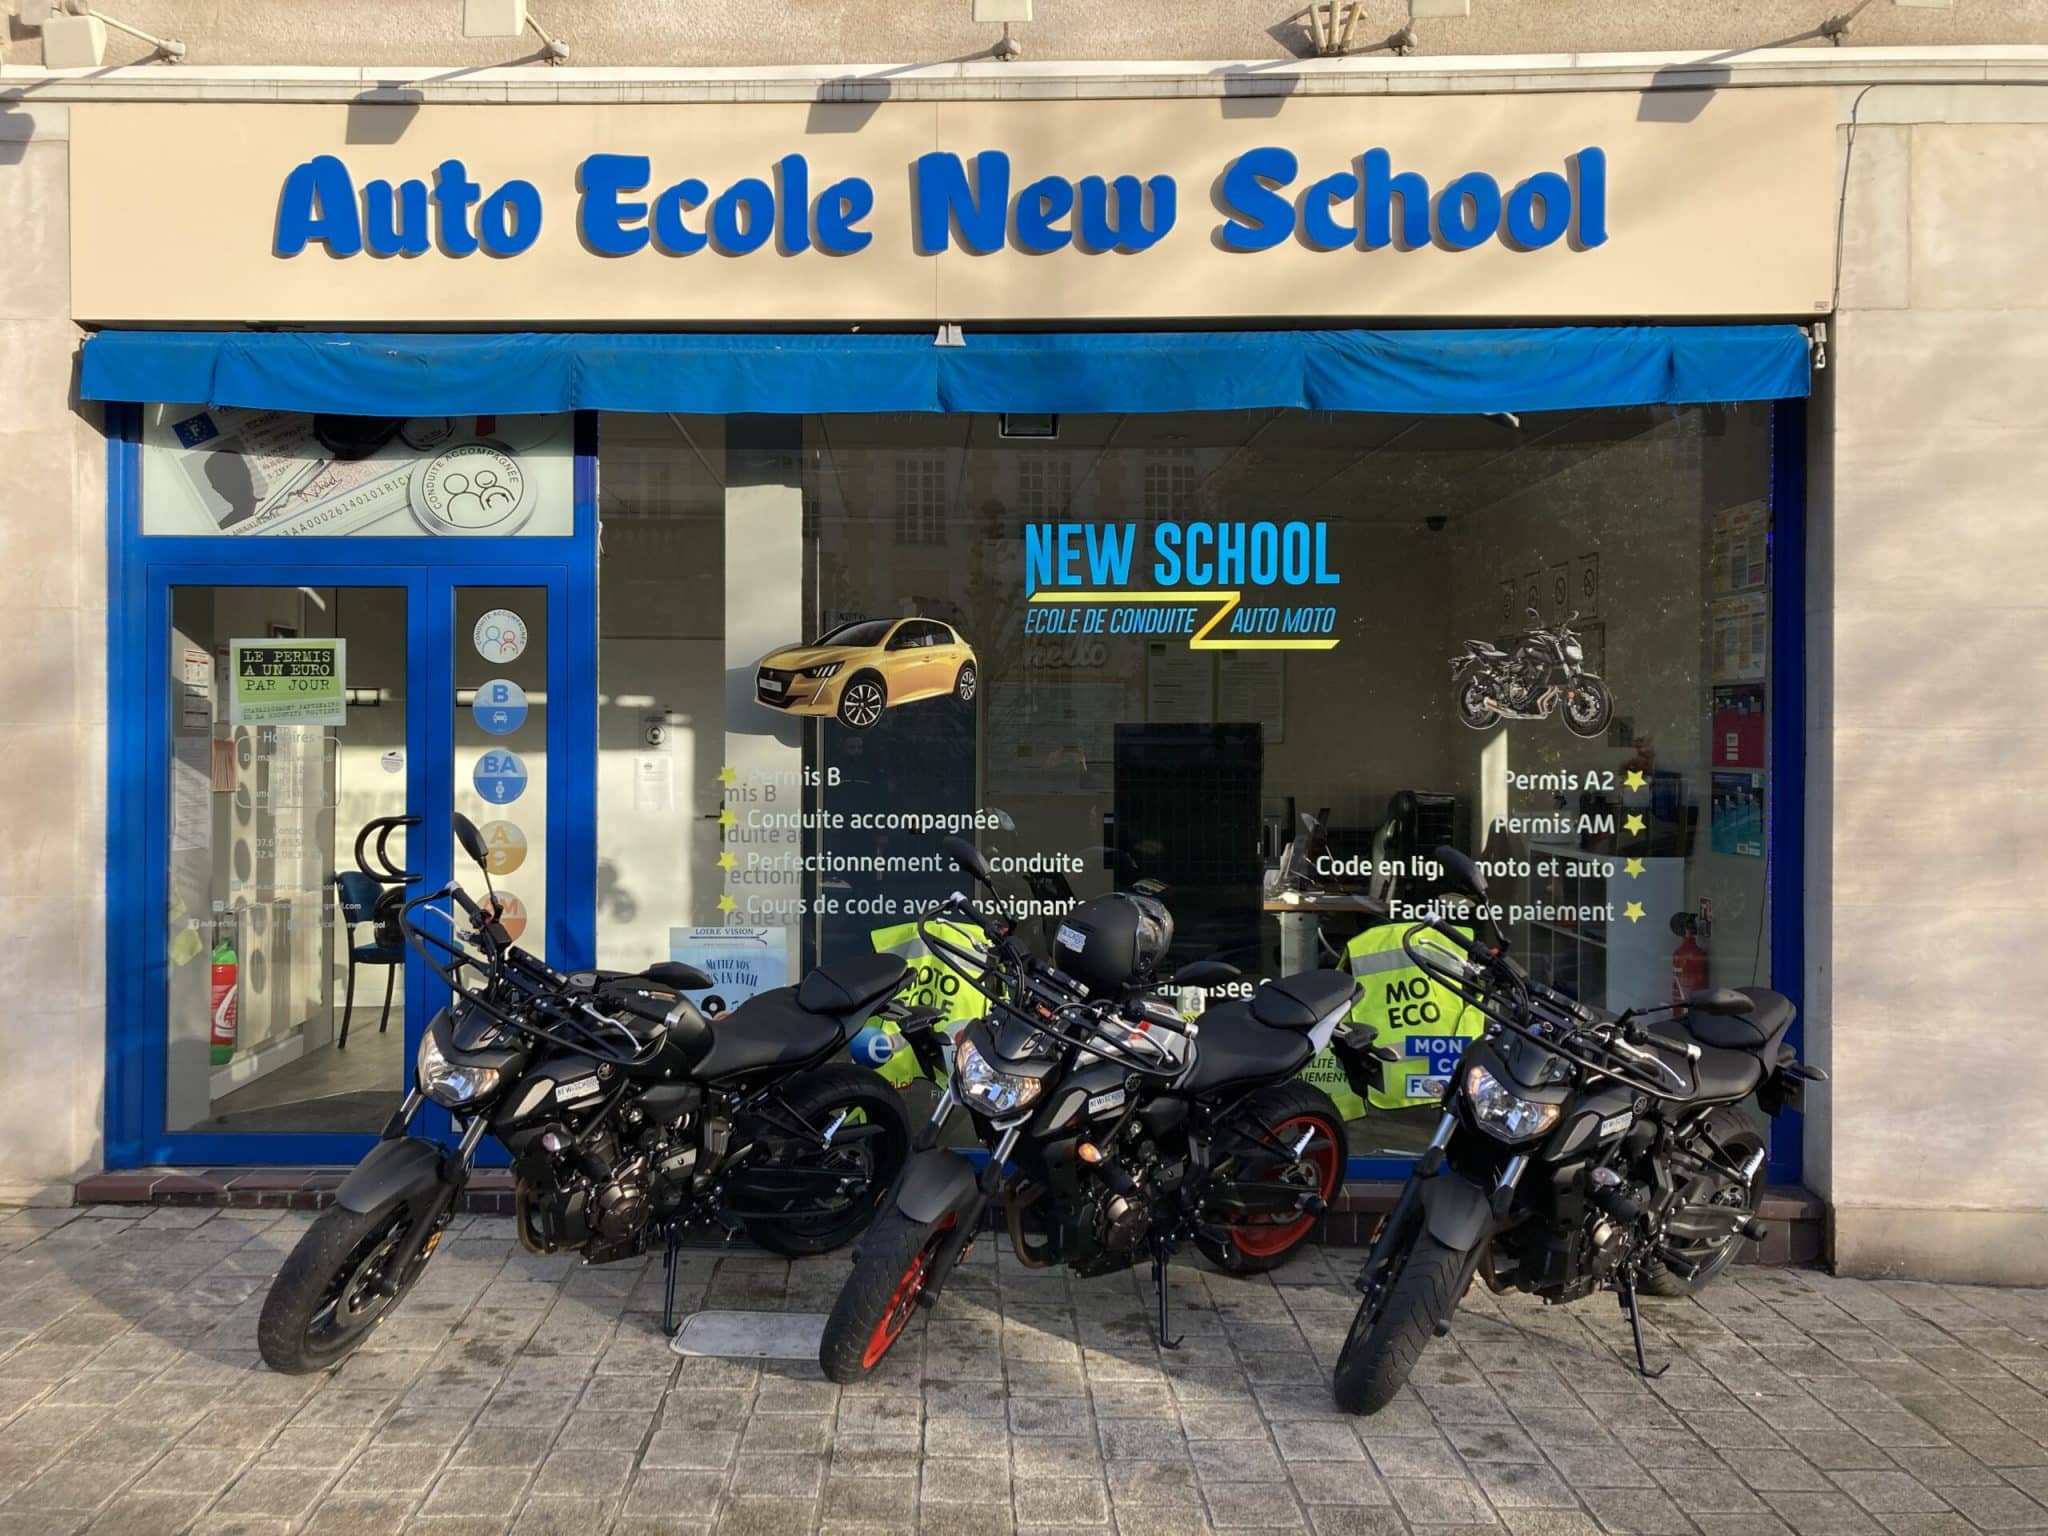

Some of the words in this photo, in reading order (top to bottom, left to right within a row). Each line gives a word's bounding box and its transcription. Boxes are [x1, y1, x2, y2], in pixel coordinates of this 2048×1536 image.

[276, 154, 542, 256] Auto
[578, 153, 873, 256] Ecole
[915, 149, 1177, 254] New
[1218, 146, 1608, 253] School
[425, 461, 445, 511] CONDUITE
[1024, 522, 1136, 598] NEW
[1153, 521, 1341, 586] SCHOOL
[1024, 607, 1081, 634] ECOLE
[1083, 607, 1108, 634] DE
[1109, 607, 1199, 634] CONDUITE
[1230, 607, 1280, 633] AUTO
[1281, 606, 1337, 633] MOTO
[243, 650, 264, 663] LE
[273, 650, 330, 663] PERMIS
[243, 664, 256, 676] A
[262, 664, 283, 676] UN
[290, 664, 330, 676] EURO
[245, 679, 276, 691] PAR
[288, 679, 331, 691] JOUR
[492, 684, 509, 703] B
[483, 756, 517, 774] BA
[827, 768, 841, 787] B
[1504, 770, 1578, 791] Permis
[1584, 771, 1615, 790] A2
[747, 809, 844, 830] Conduite
[850, 808, 1000, 835] accompagnée
[1495, 814, 1571, 834] Permis
[1576, 816, 1615, 834] AM
[490, 826, 510, 844] A
[747, 852, 943, 873] Perfectionnement
[989, 852, 1084, 873] conduite
[1316, 855, 1372, 877] Code
[1378, 859, 1409, 877] en
[1412, 855, 1444, 881] lig
[1475, 857, 1530, 877] moto
[1537, 858, 1559, 877] et
[1565, 858, 1615, 877] auto
[747, 895, 809, 916] Cours
[813, 895, 839, 915] de
[845, 895, 896, 915] code
[903, 898, 953, 915] avec
[1389, 898, 1470, 921] Facilité
[1475, 900, 1503, 921] de
[1508, 899, 1615, 925] paiement
[695, 928, 722, 936] LOIRE
[724, 928, 754, 936] VISION
[907, 965, 961, 997] OTO
[1385, 976, 1431, 1005] MO
[1415, 1038, 1463, 1055] MON
[1311, 1056, 1335, 1069] LITÉ
